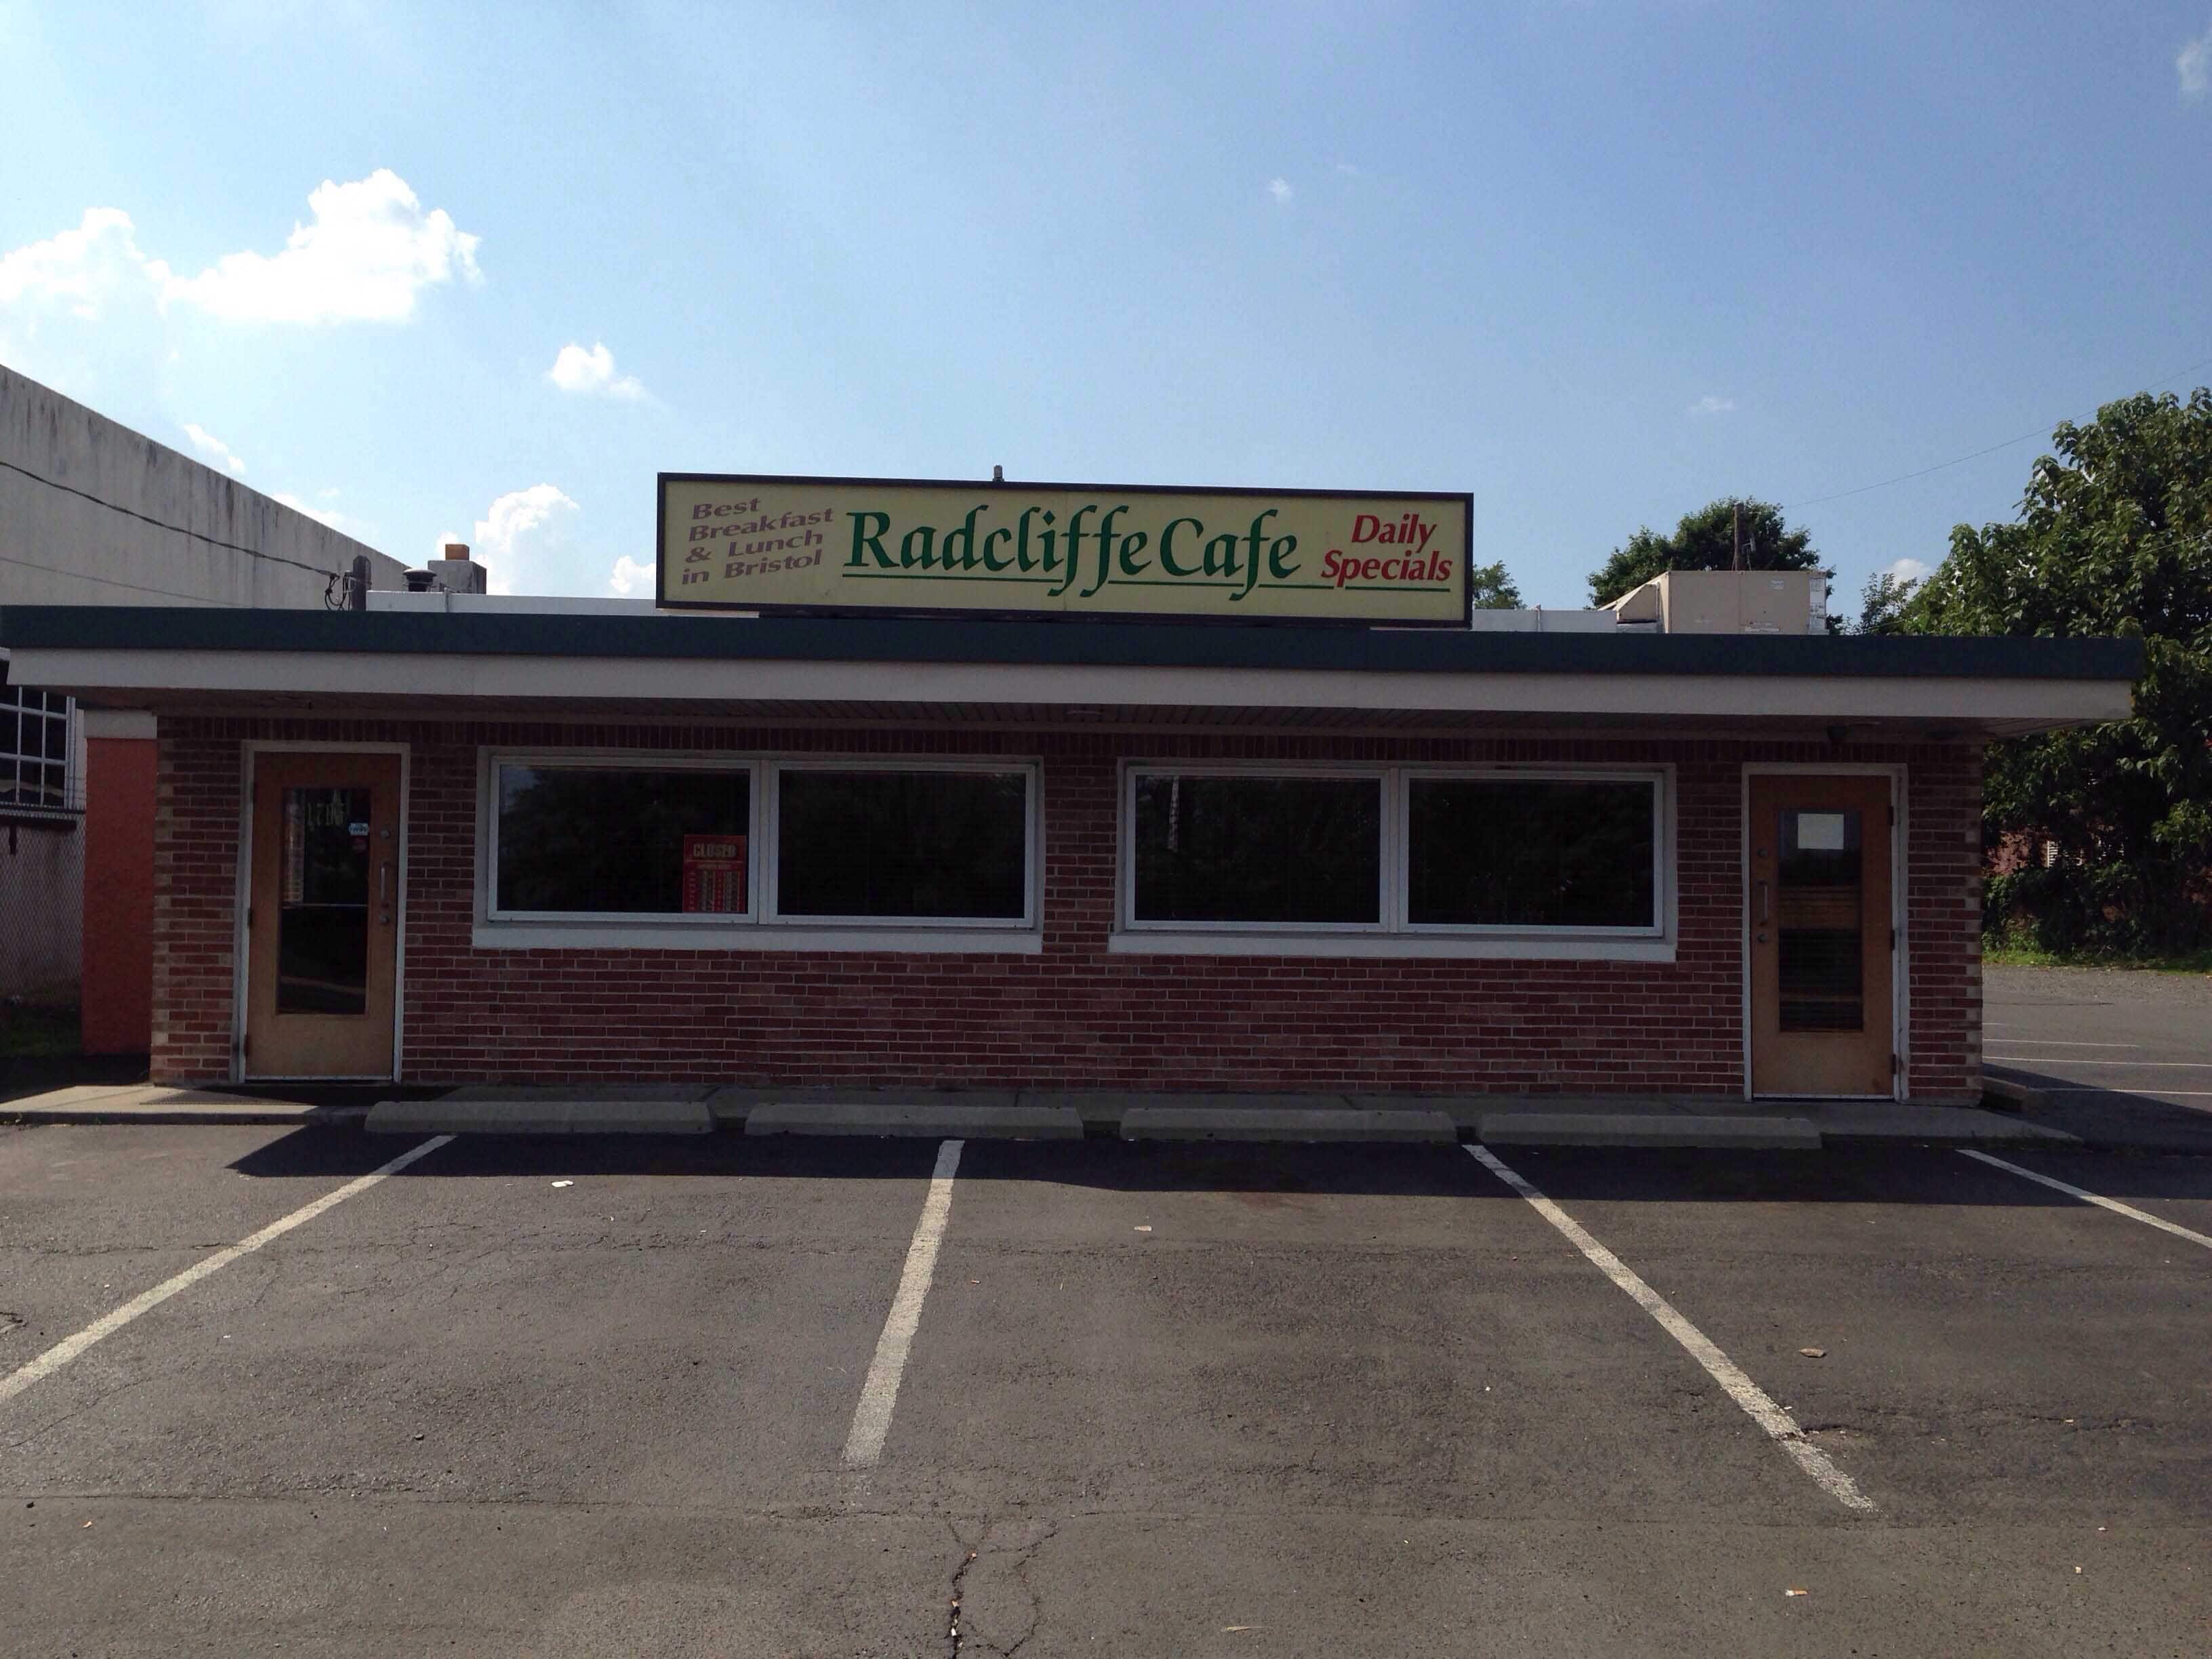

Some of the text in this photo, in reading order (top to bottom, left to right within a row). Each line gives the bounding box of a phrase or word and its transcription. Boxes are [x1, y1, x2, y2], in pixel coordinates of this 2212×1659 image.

[689, 508, 834, 541] Breakfast
[693, 498, 760, 519] Best
[685, 531, 823, 563] & Lunch
[1352, 514, 1437, 554] Daily
[682, 550, 821, 585] in Bristol
[844, 505, 1300, 600] Radcliffe Cafe
[1321, 550, 1453, 588] Specials
